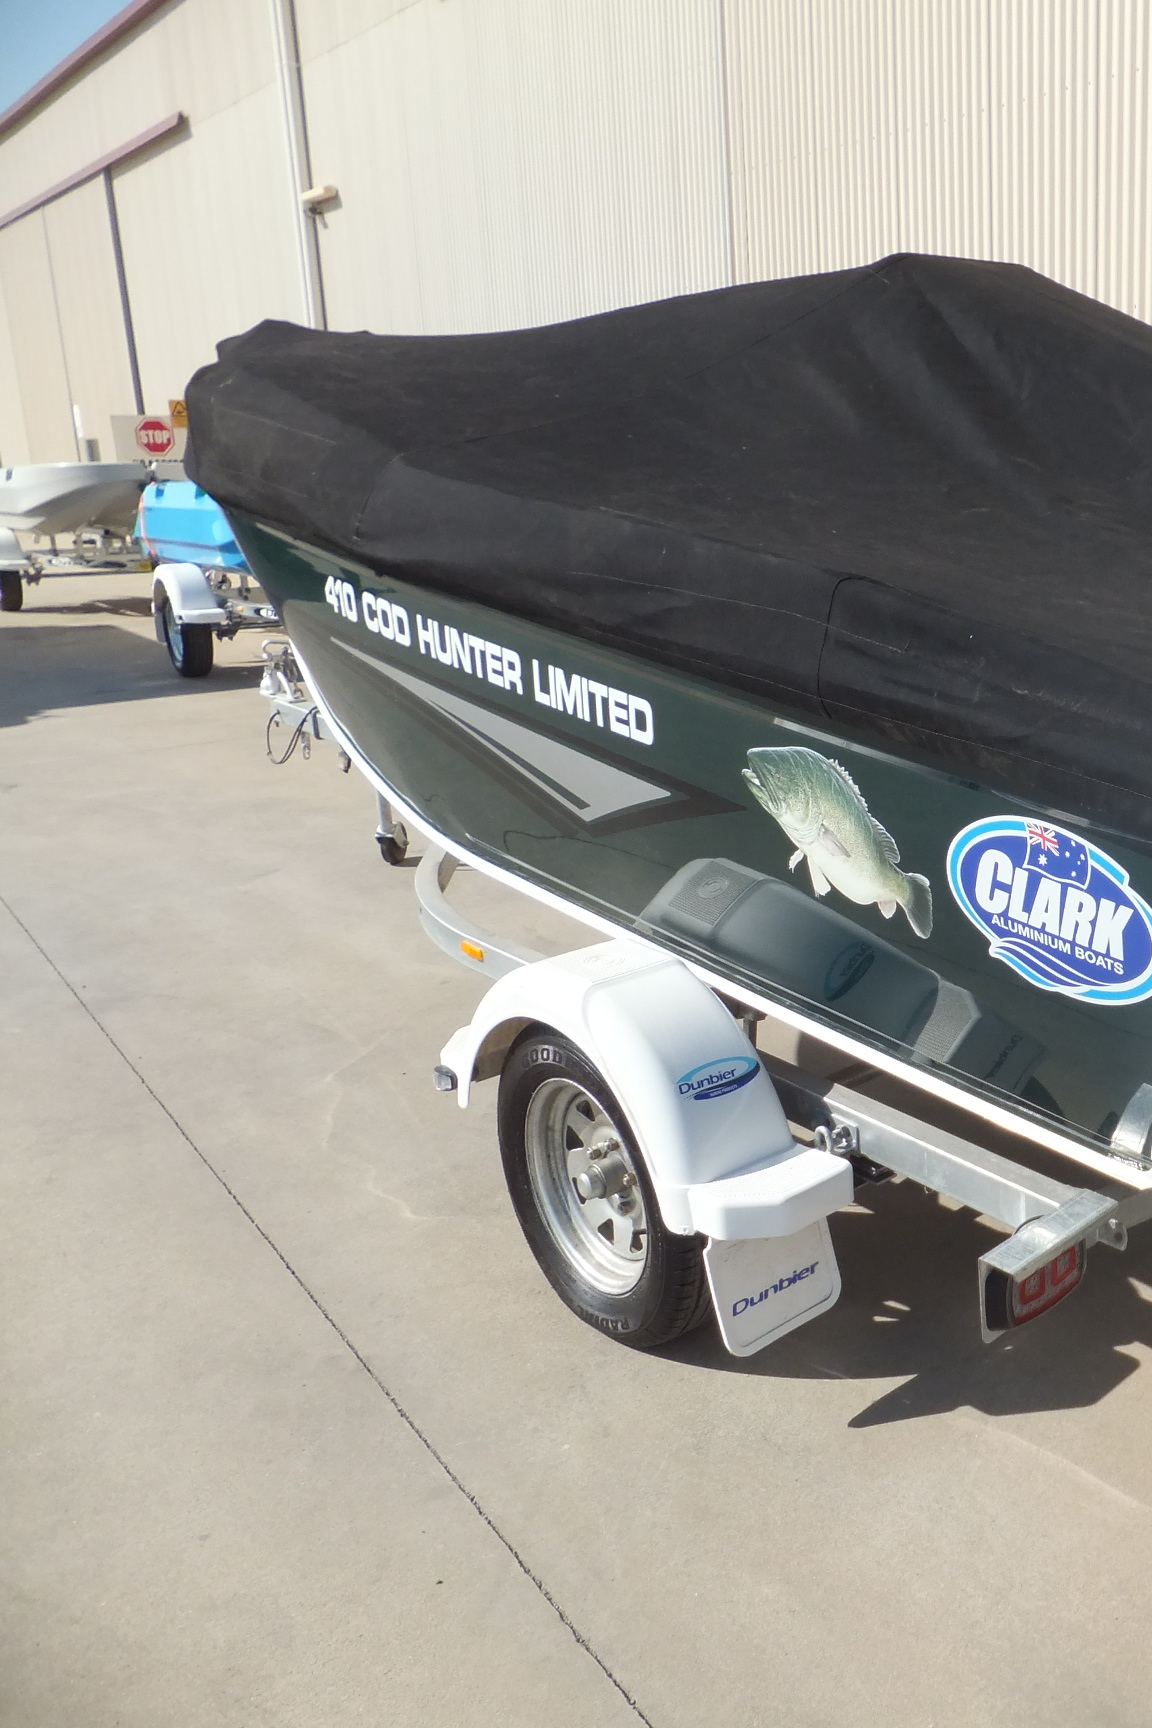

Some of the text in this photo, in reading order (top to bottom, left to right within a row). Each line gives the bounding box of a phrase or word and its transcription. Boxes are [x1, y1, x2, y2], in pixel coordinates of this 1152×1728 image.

[139, 429, 170, 444] STOP
[324, 575, 654, 745] 410 COD HUNTER LIMITED
[974, 848, 1134, 961] CLARK
[991, 914, 1124, 975] ALUMINIUM BOATS
[678, 1068, 737, 1095] Dunbier
[732, 1261, 819, 1317] Dunbier
